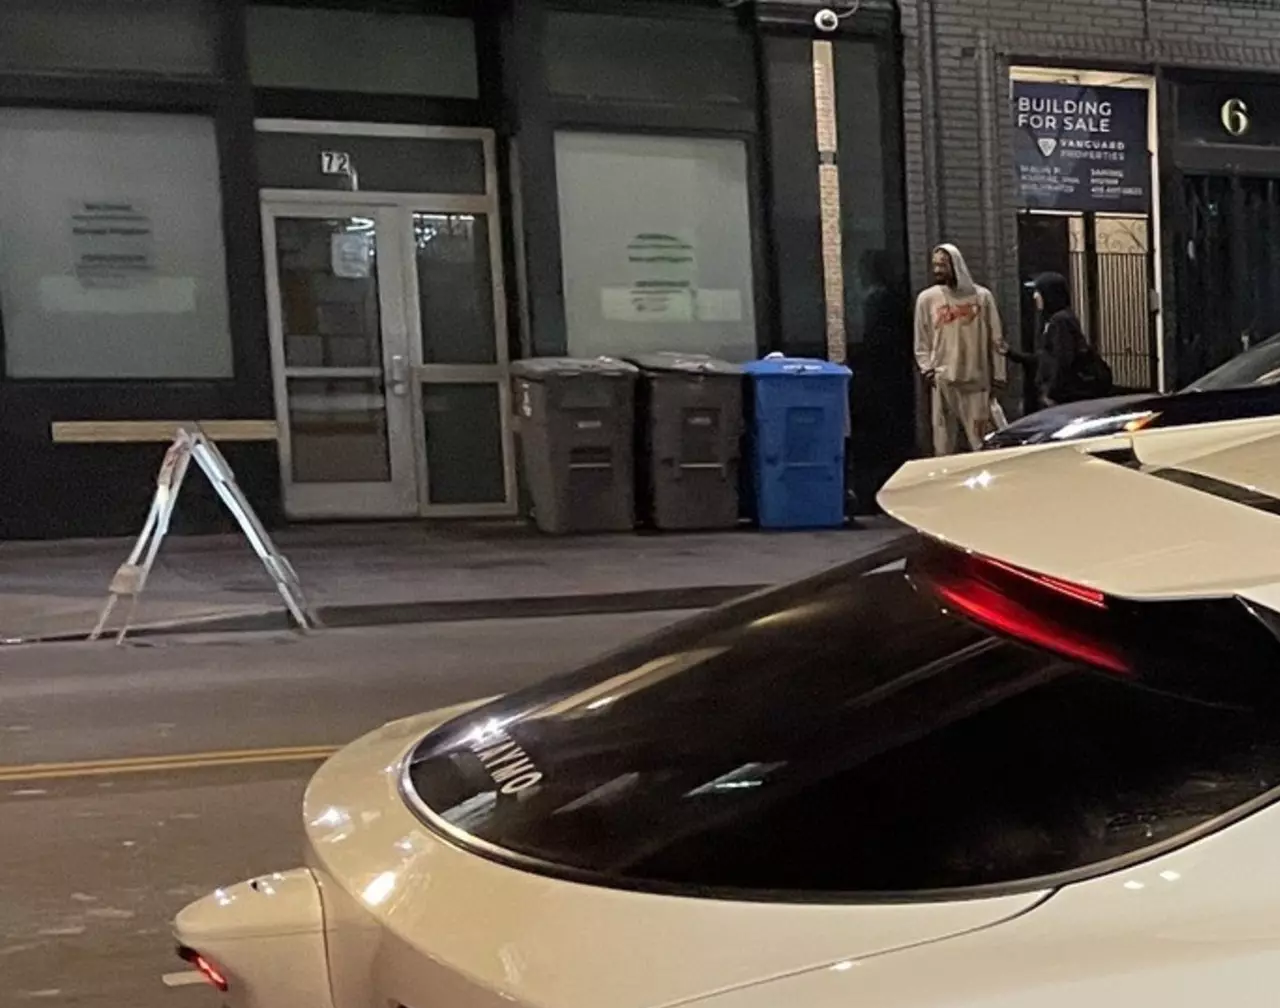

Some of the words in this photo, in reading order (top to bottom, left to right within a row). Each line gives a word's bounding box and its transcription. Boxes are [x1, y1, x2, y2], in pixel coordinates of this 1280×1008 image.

[1018, 97, 1112, 116] BUILDING
[1018, 113, 1057, 130] FOR
[1063, 116, 1111, 132] SALE
[1220, 98, 1248, 136] 6
[324, 152, 348, 172] 72
